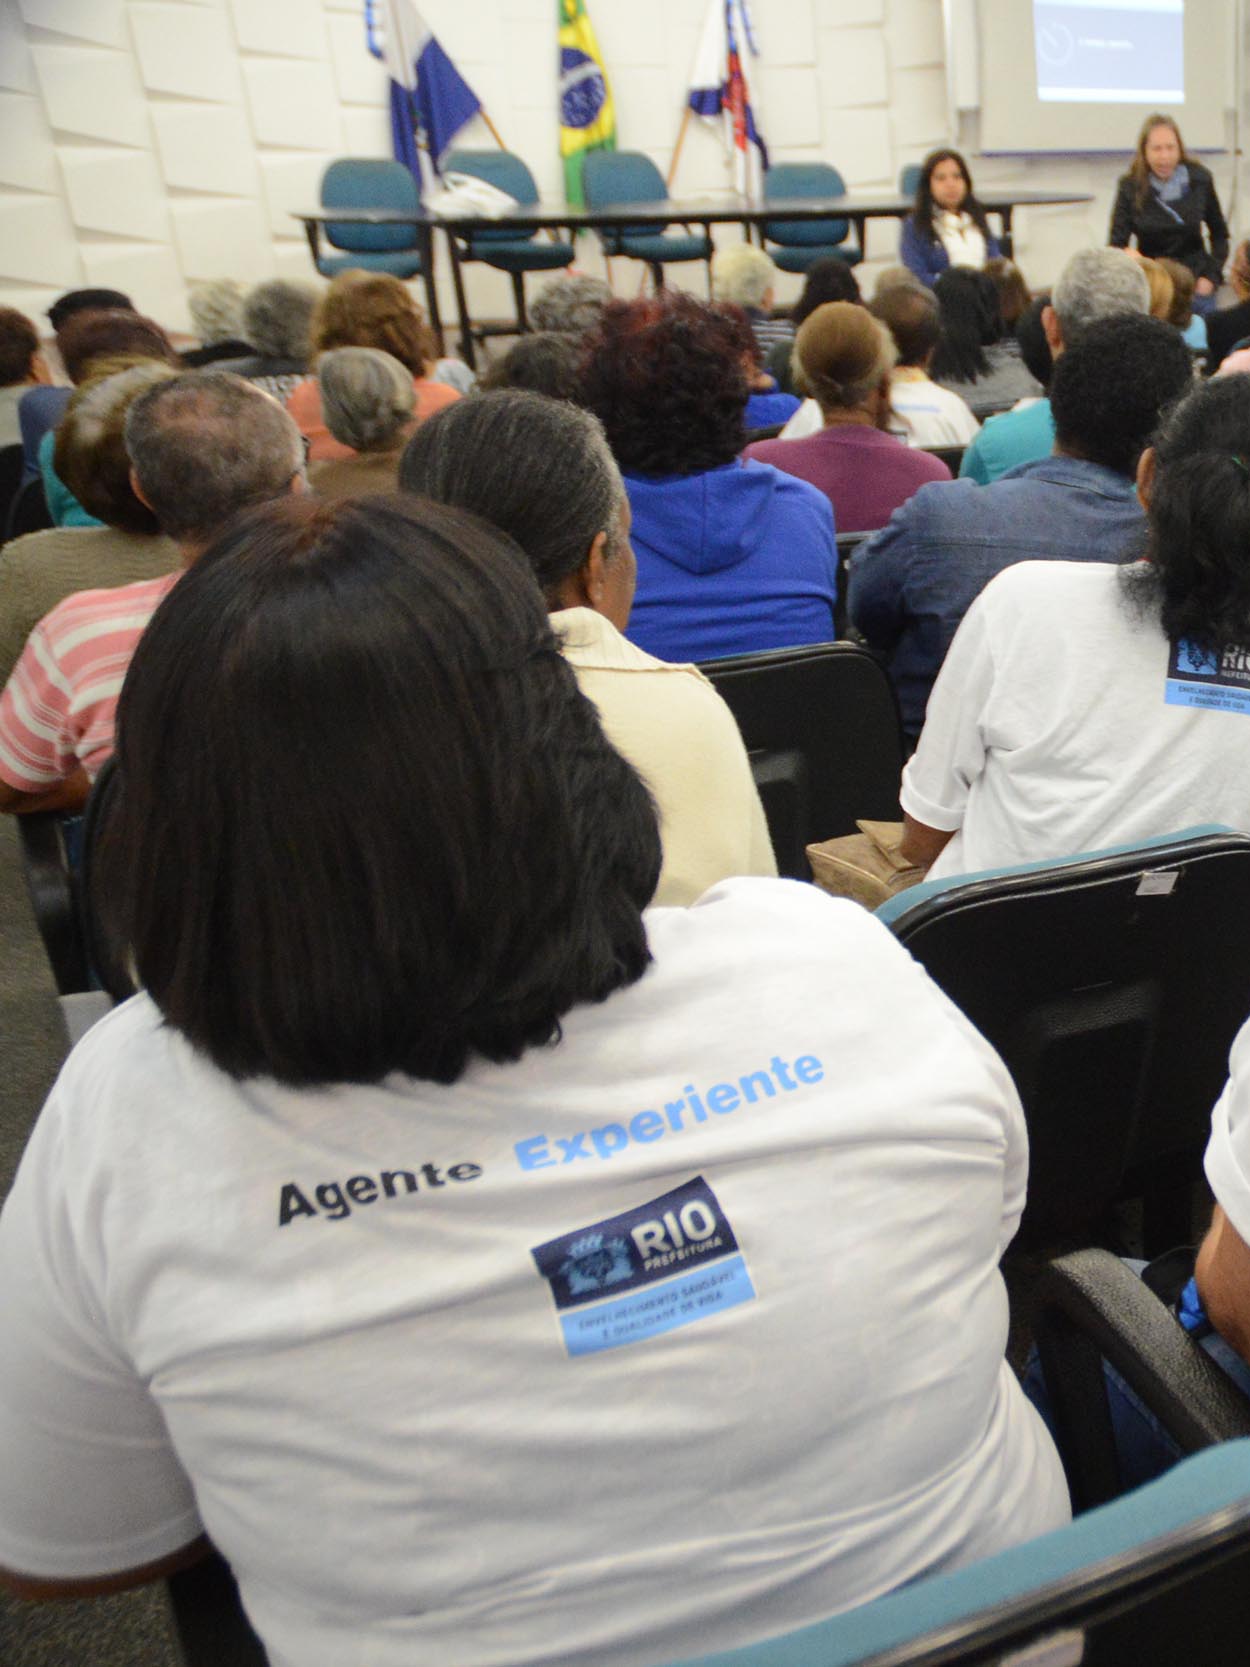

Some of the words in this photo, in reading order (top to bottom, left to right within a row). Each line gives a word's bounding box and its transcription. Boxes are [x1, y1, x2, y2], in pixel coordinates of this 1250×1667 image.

[278, 1161, 482, 1227] Agente
[514, 1054, 825, 1172] Experiente
[631, 1201, 716, 1259] RIO
[644, 1236, 722, 1272] PREFEITURA
